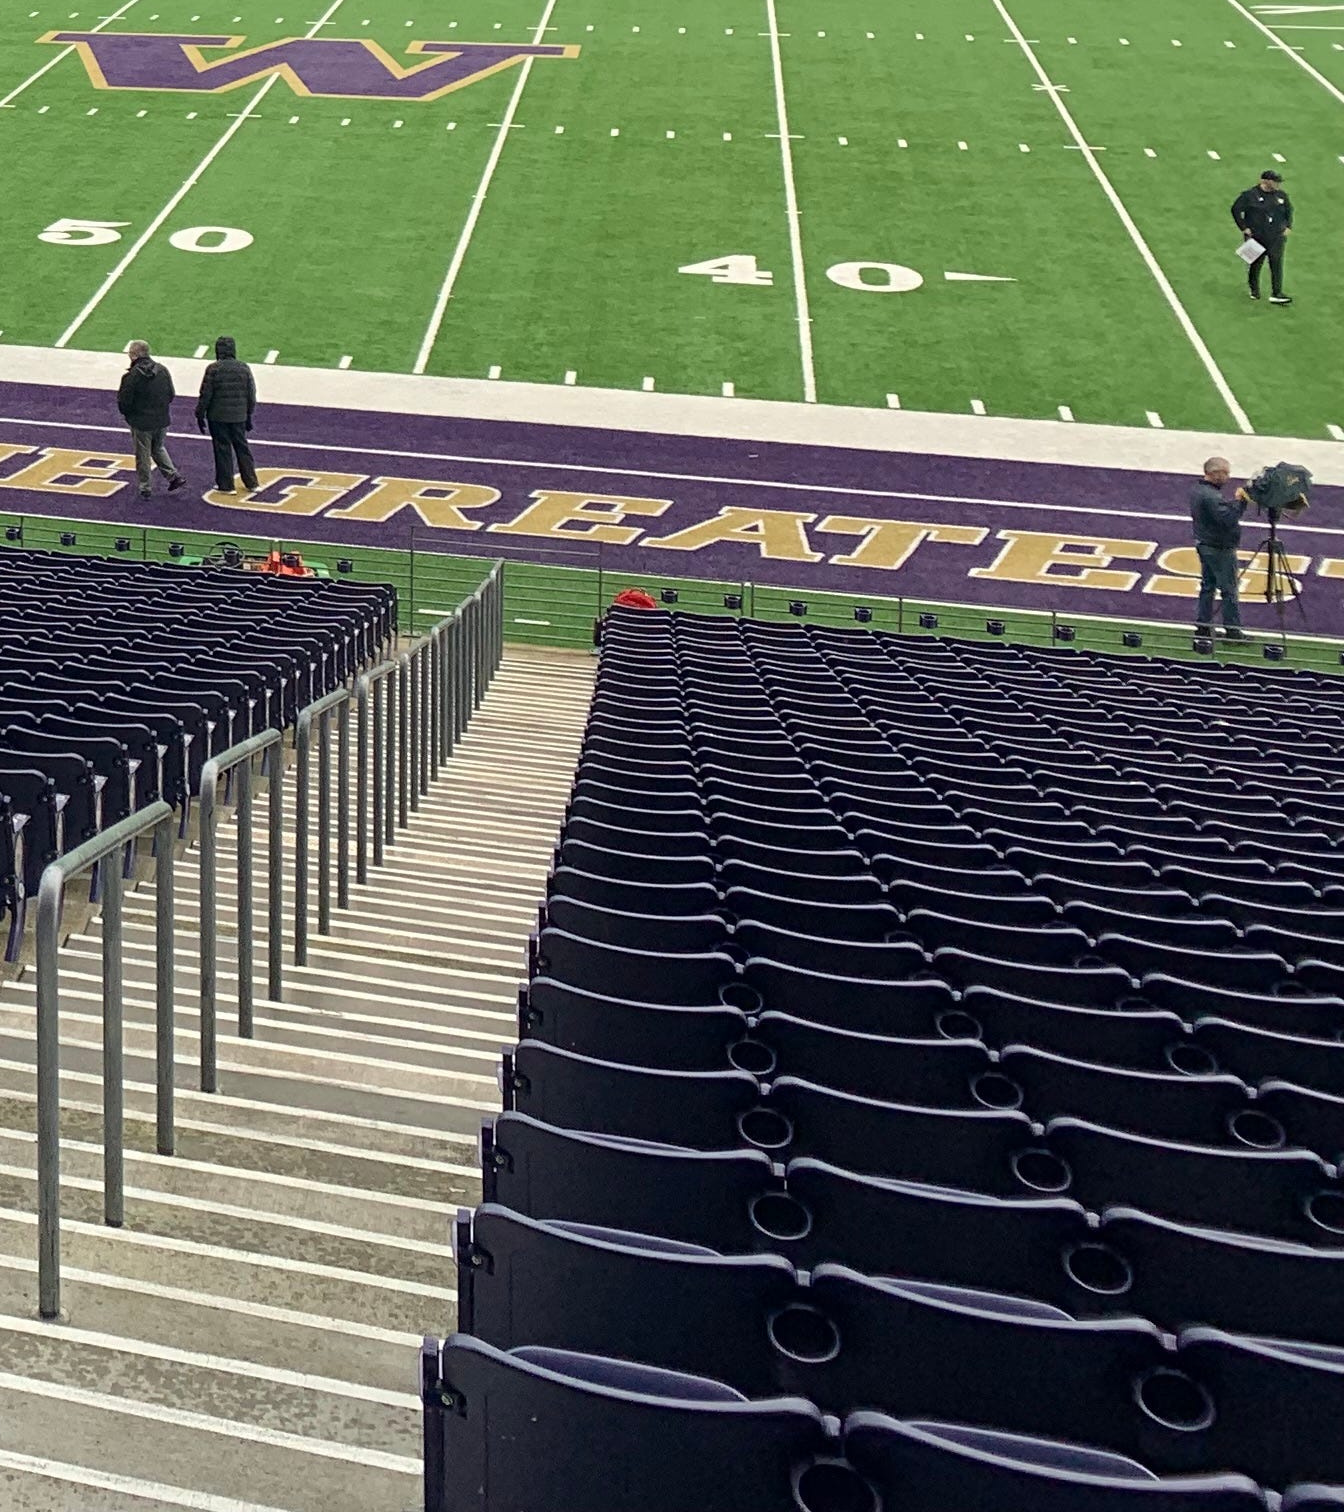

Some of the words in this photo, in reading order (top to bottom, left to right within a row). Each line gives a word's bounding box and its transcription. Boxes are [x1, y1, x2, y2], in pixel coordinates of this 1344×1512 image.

[34, 30, 582, 102] W
[37, 217, 255, 254] 50
[677, 253, 925, 294] 40
[201, 466, 1344, 604] GREATES
